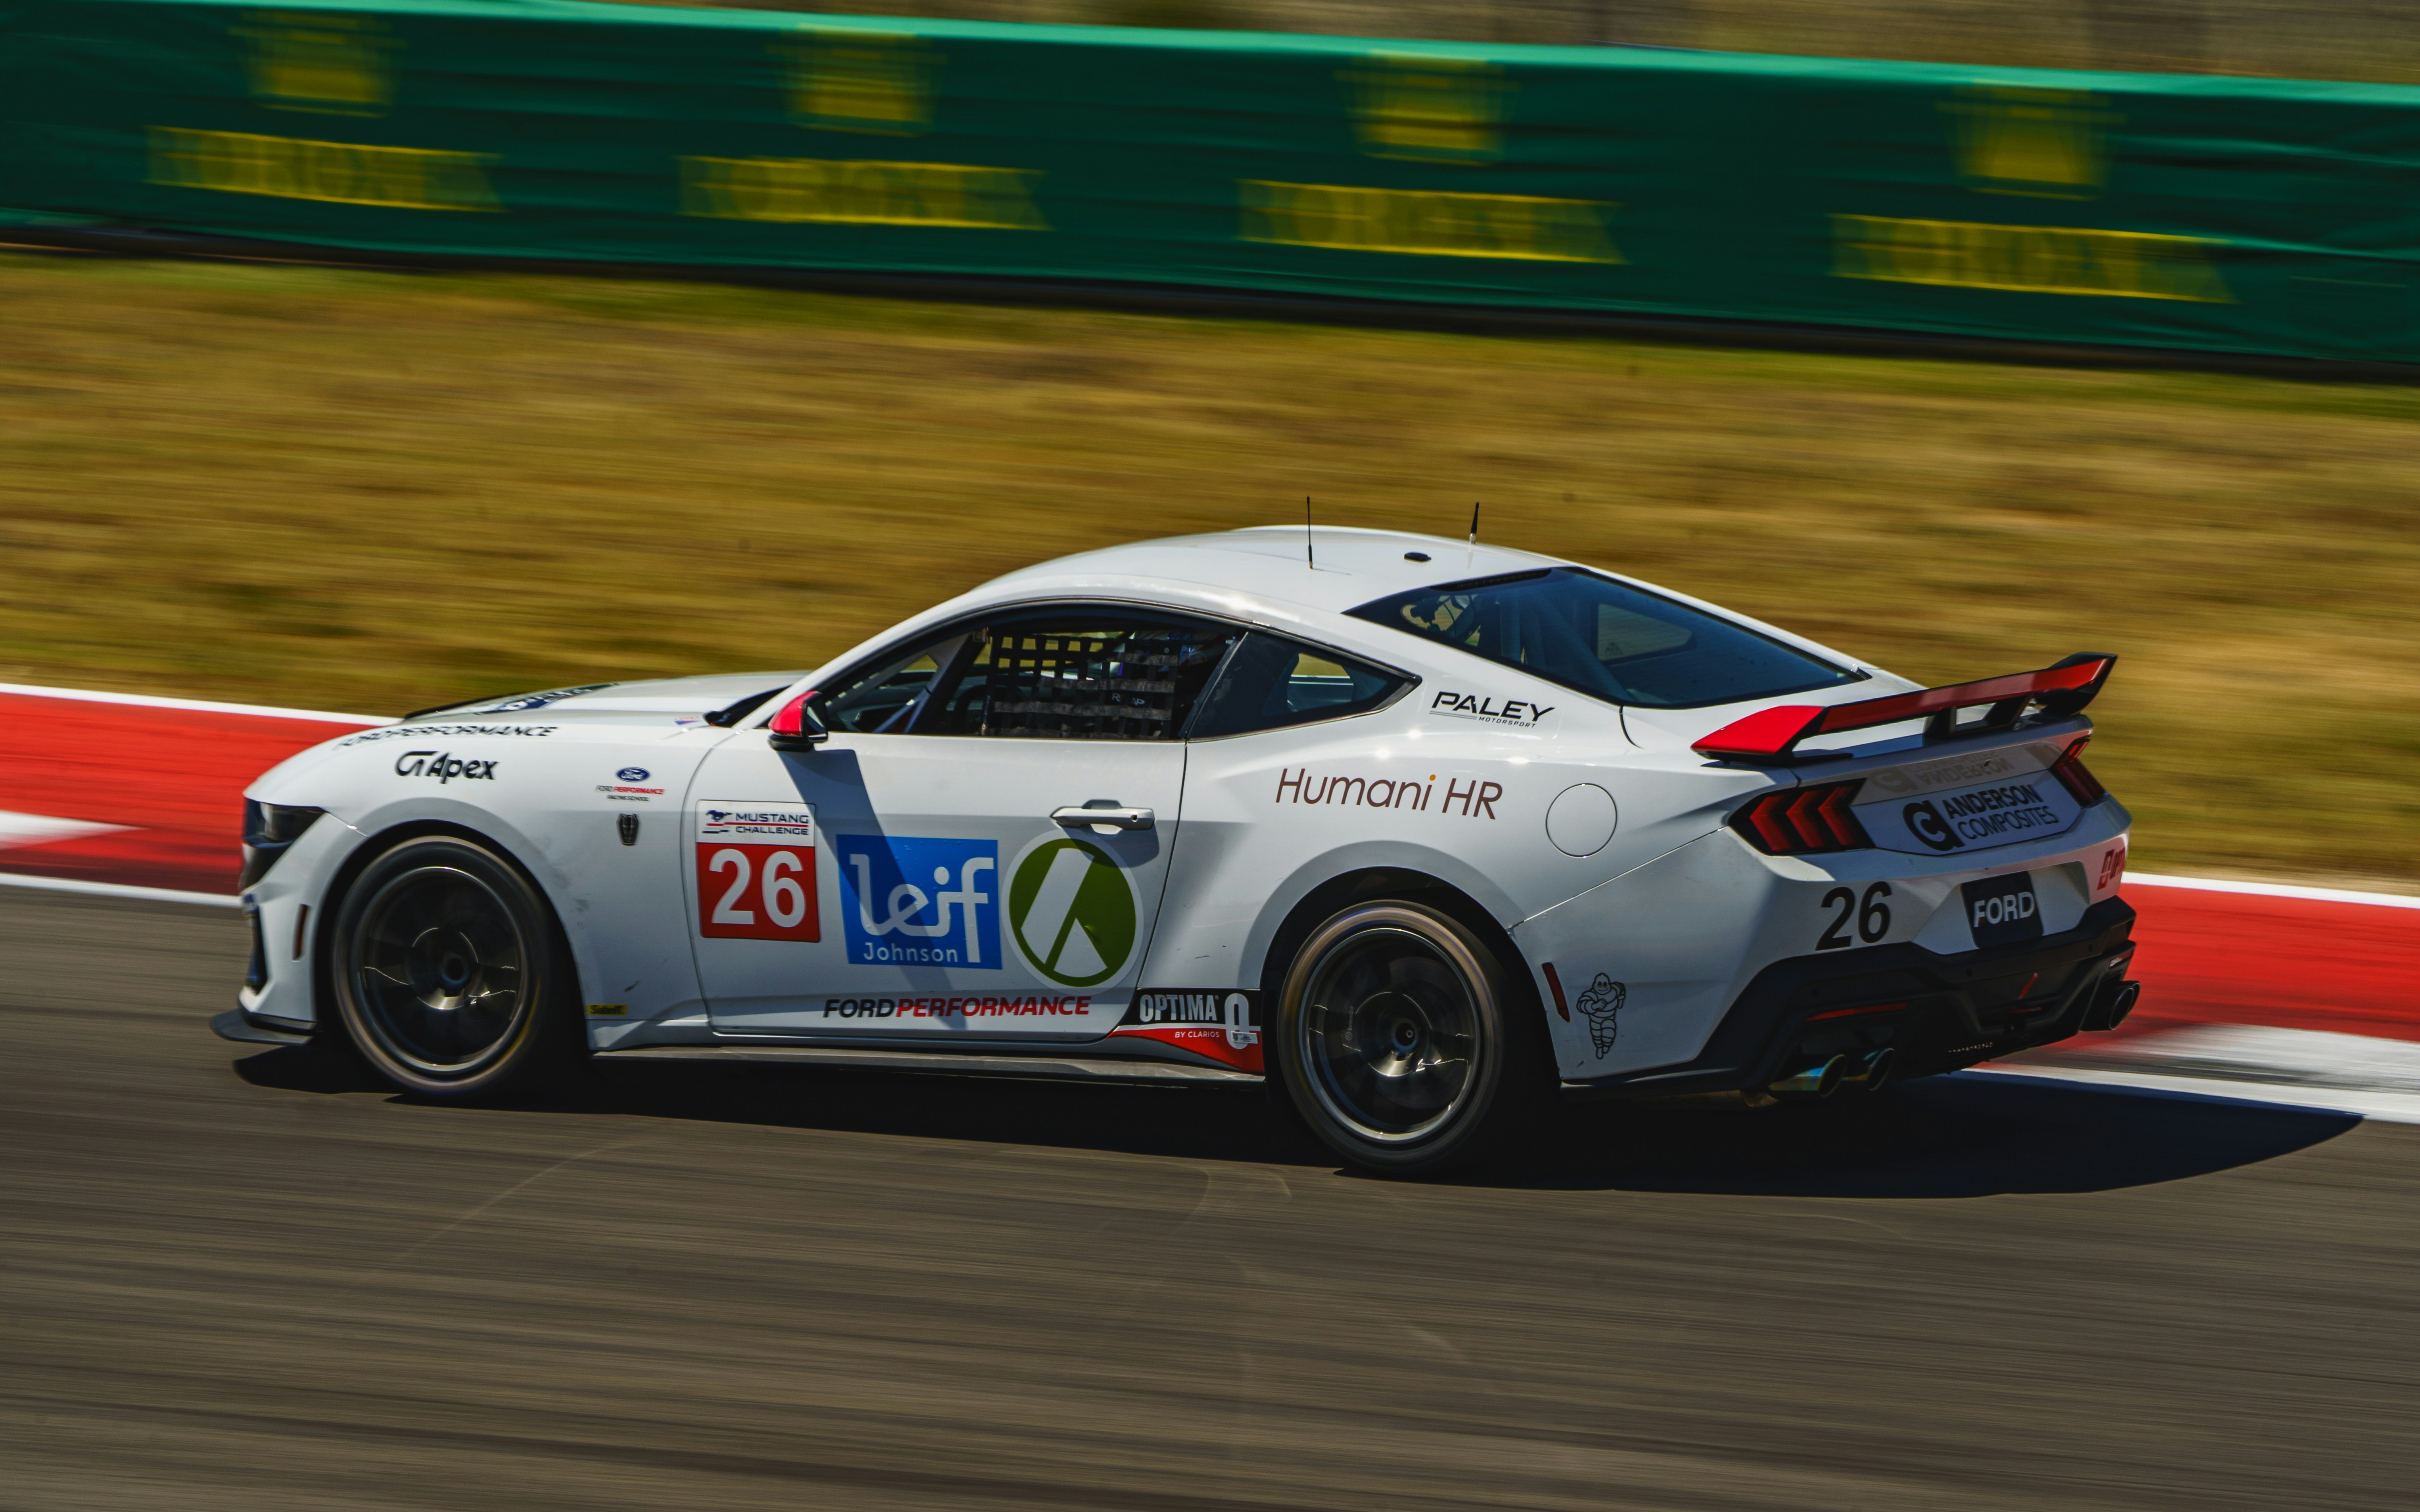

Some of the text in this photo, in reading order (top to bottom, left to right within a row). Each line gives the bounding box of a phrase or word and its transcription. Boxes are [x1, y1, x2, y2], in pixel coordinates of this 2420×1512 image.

[1432, 691, 1555, 722] PALEY
[1478, 716, 1536, 728] MOTORSPORT
[1275, 768, 1503, 820] Humani HR
[1942, 784, 2045, 820] ANDERSON
[735, 812, 810, 824] MUSTANG
[735, 826, 809, 835] CHALLENGE
[1957, 806, 2059, 840] COMPOSITES
[709, 848, 805, 927] 26
[849, 854, 994, 963] leif
[1815, 881, 1892, 951] 26
[1973, 891, 2035, 928] FORD
[864, 941, 959, 962] Johnson
